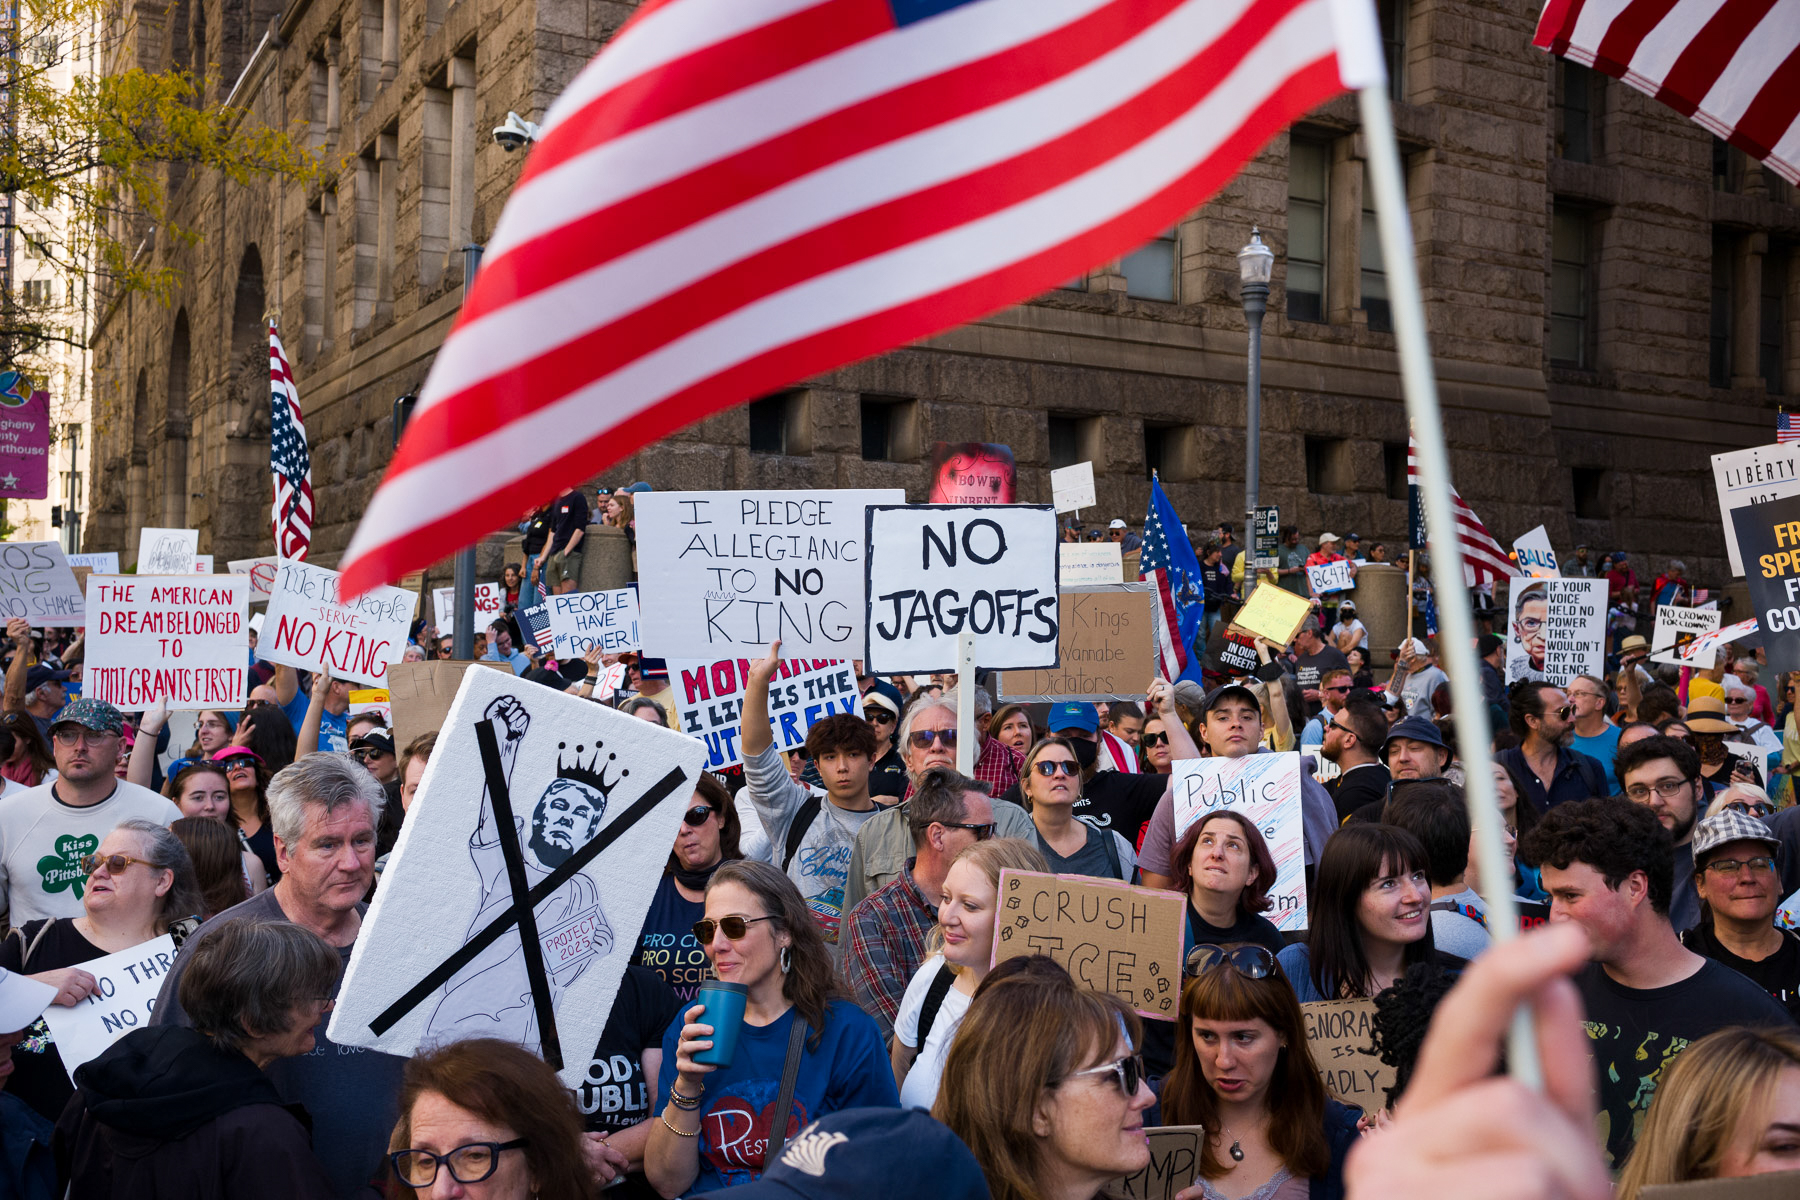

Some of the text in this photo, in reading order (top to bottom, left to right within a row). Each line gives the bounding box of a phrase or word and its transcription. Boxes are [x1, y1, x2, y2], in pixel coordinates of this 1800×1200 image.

[1, 419, 35, 432] gheny
[1, 444, 45, 456] rthouse
[1726, 459, 1795, 487] LIBERTY
[679, 499, 832, 525] I PLEDGE
[1257, 511, 1266, 519] BUS
[922, 518, 1008, 570] NO
[1773, 521, 1800, 548] FR
[3, 545, 54, 570] OS
[679, 534, 858, 561] ALLEGIANC
[68, 556, 108, 567] MPATHY
[707, 567, 824, 596] TO NO
[1312, 566, 1350, 587] 8647!
[1550, 582, 1591, 592] IF YOUR
[98, 581, 233, 605] THE AMERICAN
[1549, 593, 1580, 605] VOICE
[32, 595, 84, 616] SHAME
[474, 598, 500, 614] NGS
[556, 593, 628, 615] PEOPLE
[1072, 593, 1130, 636] Kings
[1548, 605, 1595, 617] HELD NO
[100, 611, 240, 635] DREAM BELONGED
[576, 612, 617, 631] HAVE
[706, 599, 852, 645] KING
[876, 588, 1058, 643] JAGOFFS
[1548, 616, 1587, 628] POWER
[1660, 607, 1716, 624] NO CROWNS
[1766, 606, 1800, 632] CO
[554, 633, 567, 649] THE
[1548, 629, 1576, 640] THEY
[158, 638, 182, 658] TO
[274, 614, 391, 678] NO KING
[1227, 642, 1258, 660] IN OUR
[1547, 640, 1600, 652] WOULDN'T
[1220, 652, 1257, 671] STREETS
[1547, 652, 1585, 664] TRY TO
[1546, 664, 1590, 676] SILENCE
[91, 667, 242, 706] IMMIGRANTS FIRST!
[1034, 667, 1114, 696] Dictators
[1546, 675, 1567, 687] YOU
[684, 710, 703, 733] I
[768, 684, 799, 711] IS
[804, 670, 853, 701] THE
[1184, 773, 1278, 808] Public
[62, 840, 93, 852] Kiss
[68, 851, 86, 861] Me
[1033, 891, 1147, 934] CRUSH
[545, 915, 597, 953] PROJECT
[642, 933, 676, 948] PRO
[560, 936, 591, 961] 2025
[641, 949, 705, 966] PRO LO
[672, 967, 713, 984] SCIE
[100, 1009, 138, 1034] NO
[1303, 1010, 1378, 1041] GNORA
[1331, 1045, 1355, 1059] IS
[586, 1054, 633, 1085] OD
[1320, 1070, 1380, 1095] ADLY
[576, 1083, 649, 1115] UBLE
